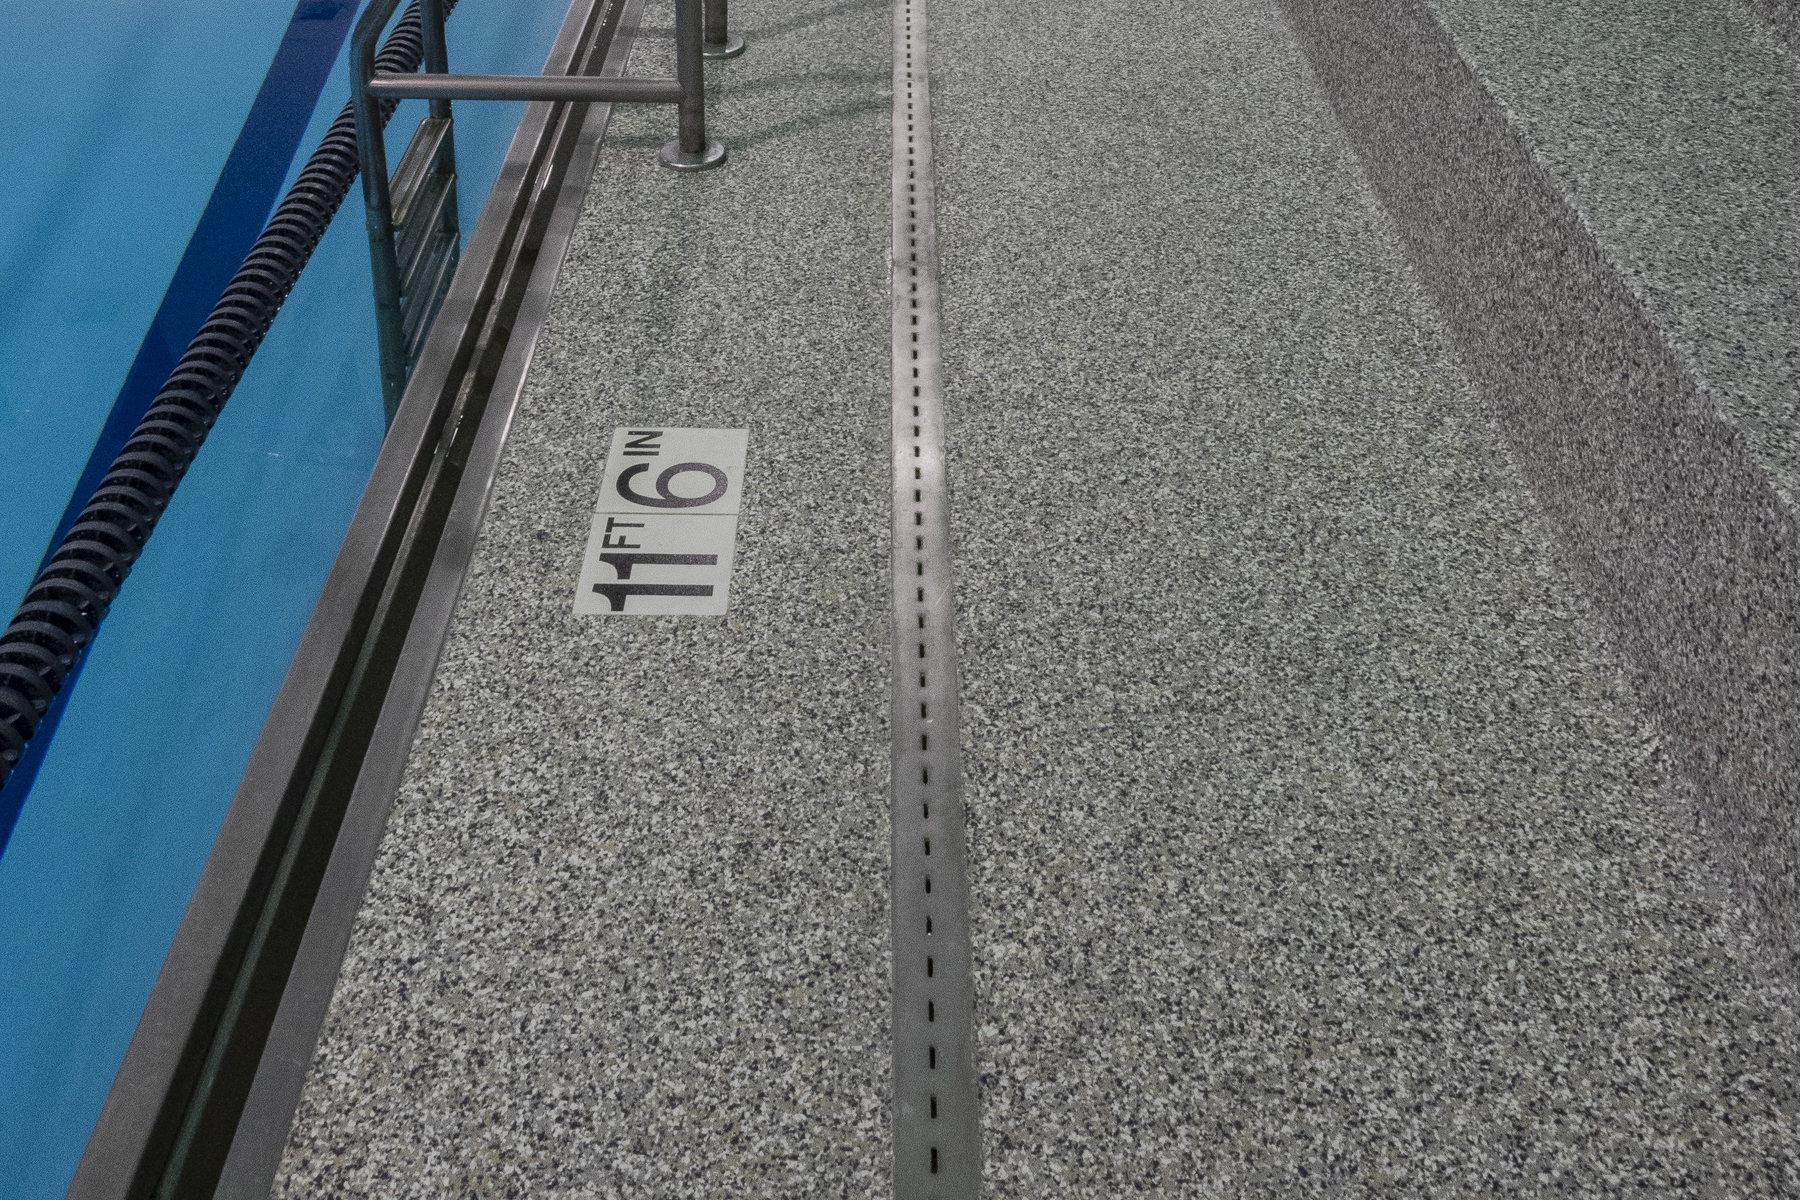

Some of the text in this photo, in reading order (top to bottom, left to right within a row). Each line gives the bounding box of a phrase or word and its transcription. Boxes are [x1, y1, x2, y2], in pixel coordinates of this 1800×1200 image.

[592, 430, 729, 612] 11 FT 6 IN
